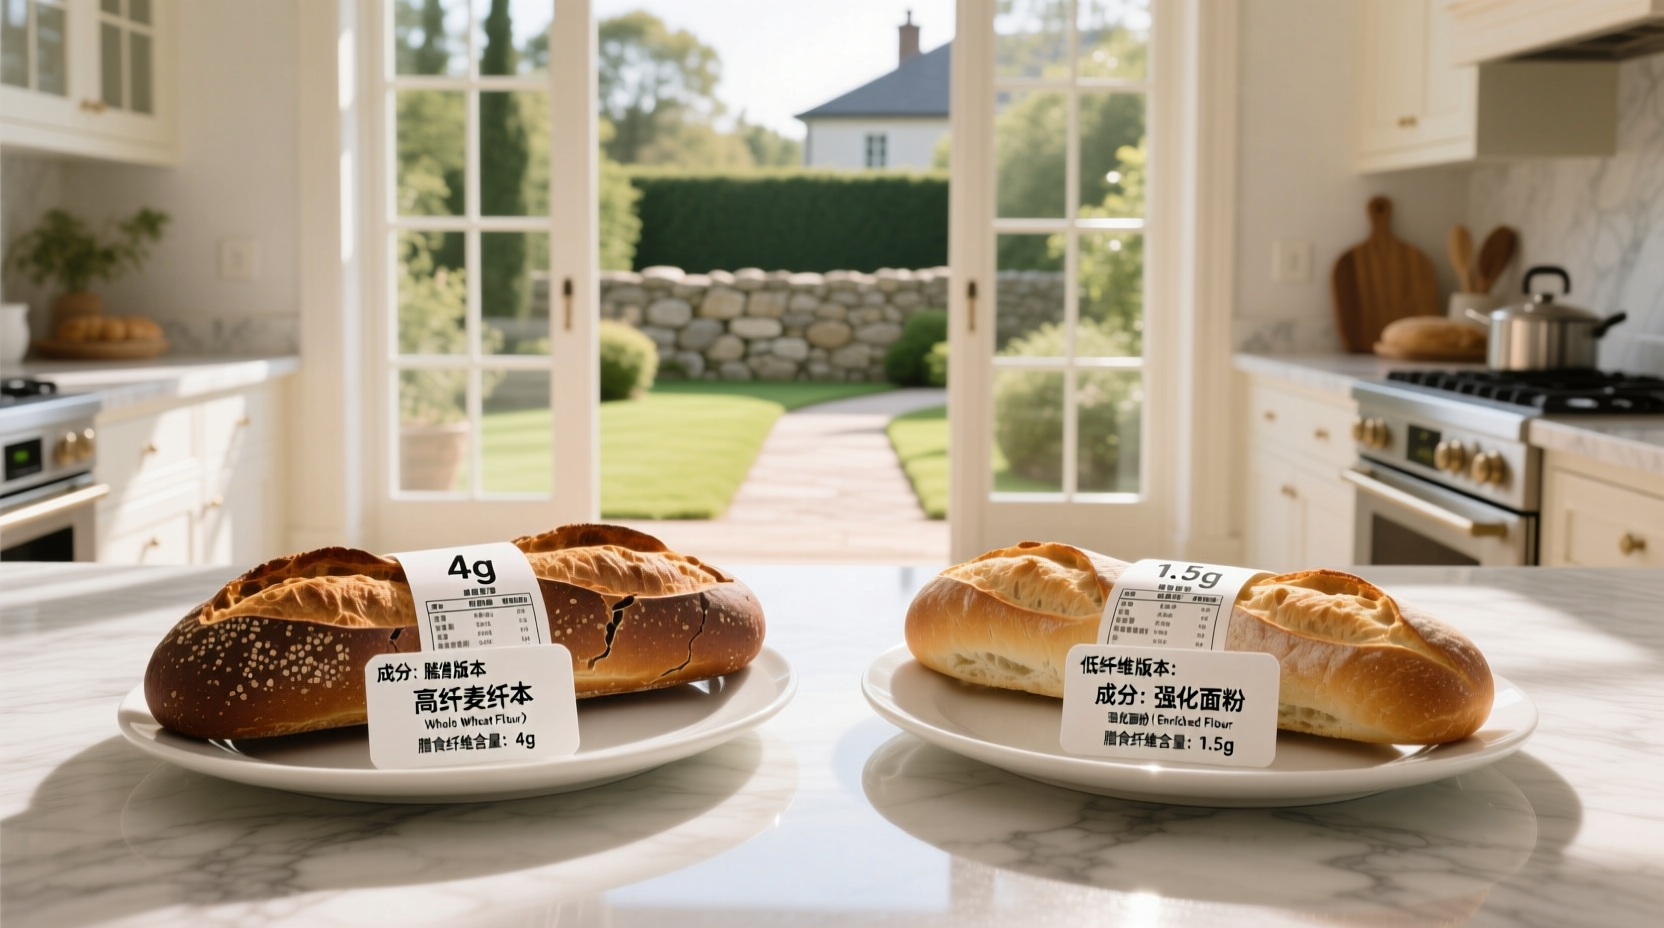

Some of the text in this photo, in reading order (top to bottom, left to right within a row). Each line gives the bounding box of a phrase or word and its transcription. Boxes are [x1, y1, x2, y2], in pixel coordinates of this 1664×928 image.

[448, 555, 496, 585] 4g
[1158, 563, 1223, 590] 1.5g
[413, 681, 533, 715] 高纤麦纤本
